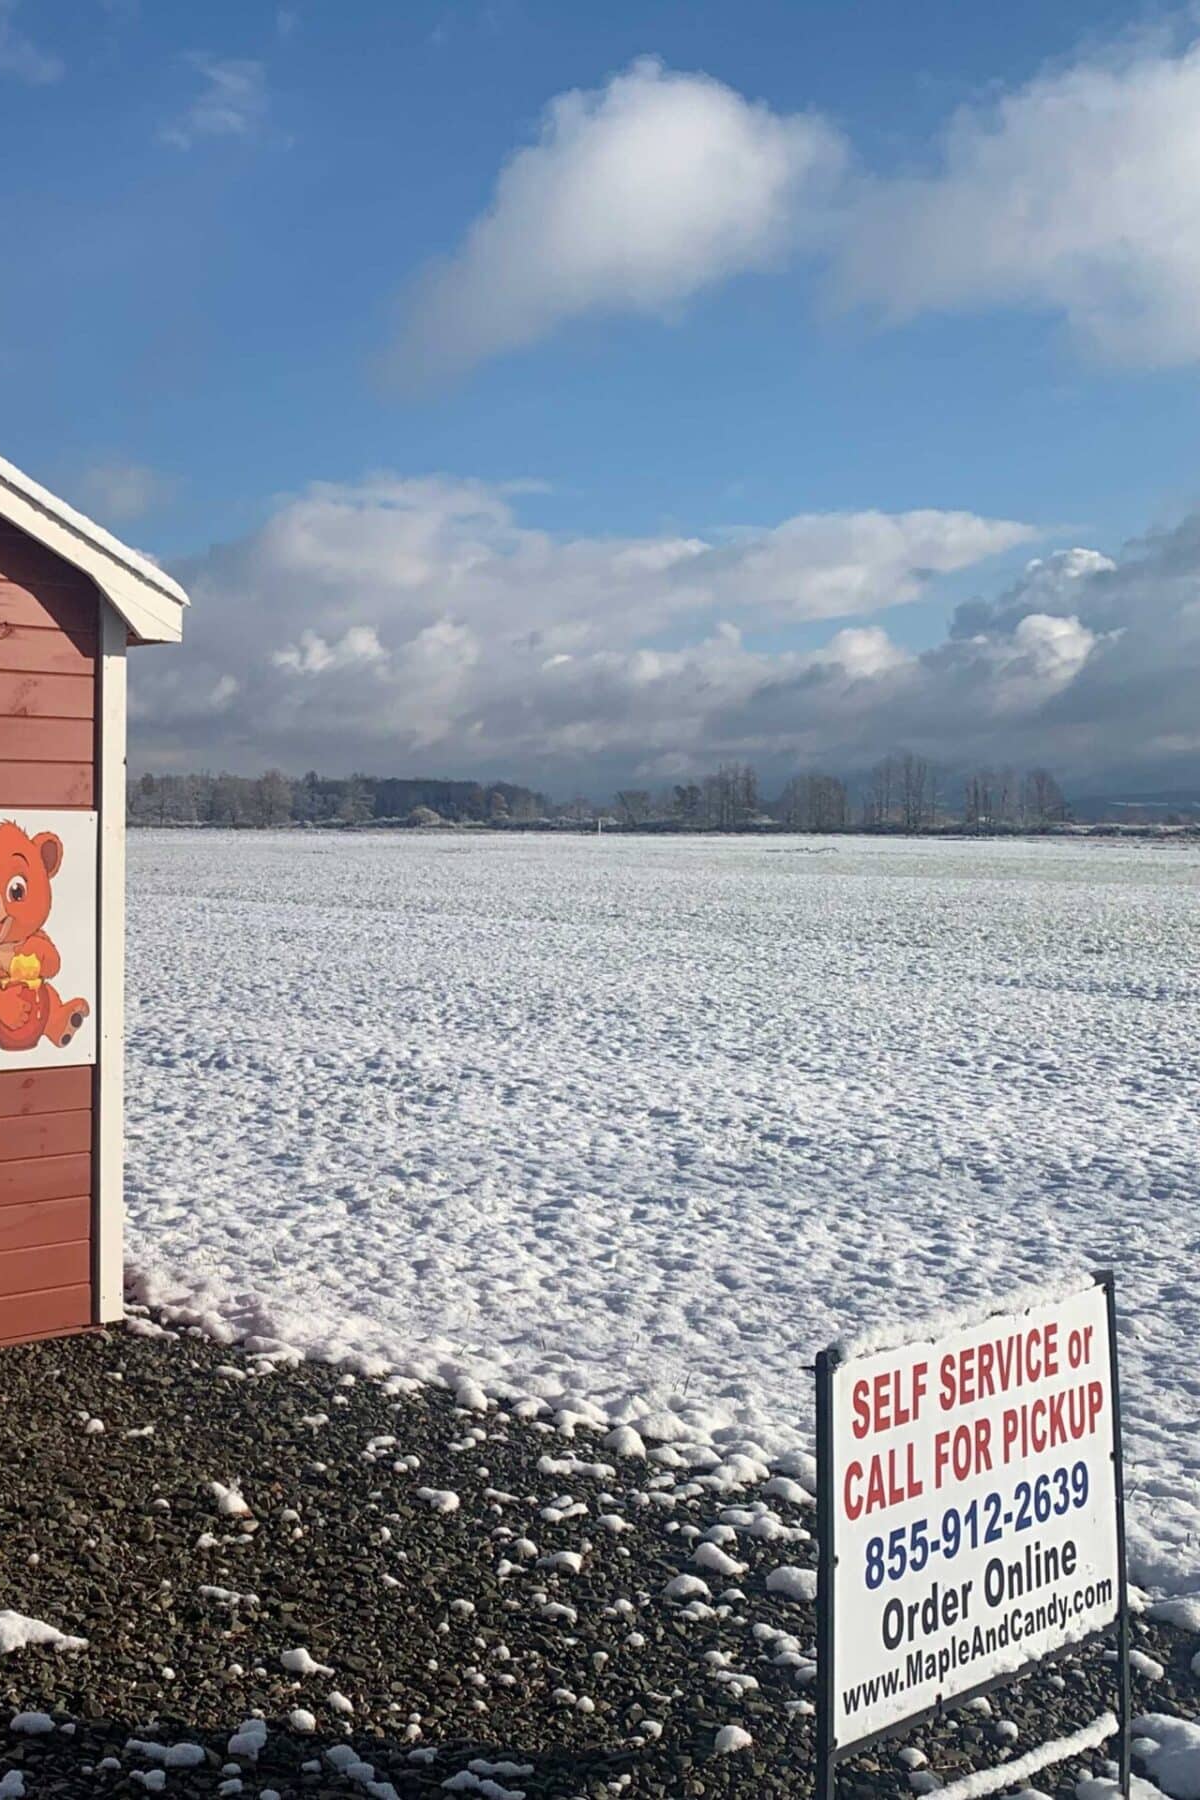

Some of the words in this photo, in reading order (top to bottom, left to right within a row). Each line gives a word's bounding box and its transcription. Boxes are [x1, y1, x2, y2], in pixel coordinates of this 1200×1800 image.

[852, 1362, 928, 1439] SELF
[939, 1322, 1058, 1411] SERVICE
[1068, 1325, 1093, 1369] or
[844, 1442, 923, 1521] CALL
[934, 1418, 993, 1489] FOR
[1003, 1380, 1103, 1464] PICKUP
[865, 1461, 1089, 1590] 855-912-2639
[843, 1578, 1112, 1715] www.MapleAndCandy.com
[882, 1582, 973, 1650] Order
[984, 1540, 1077, 1608] Online
